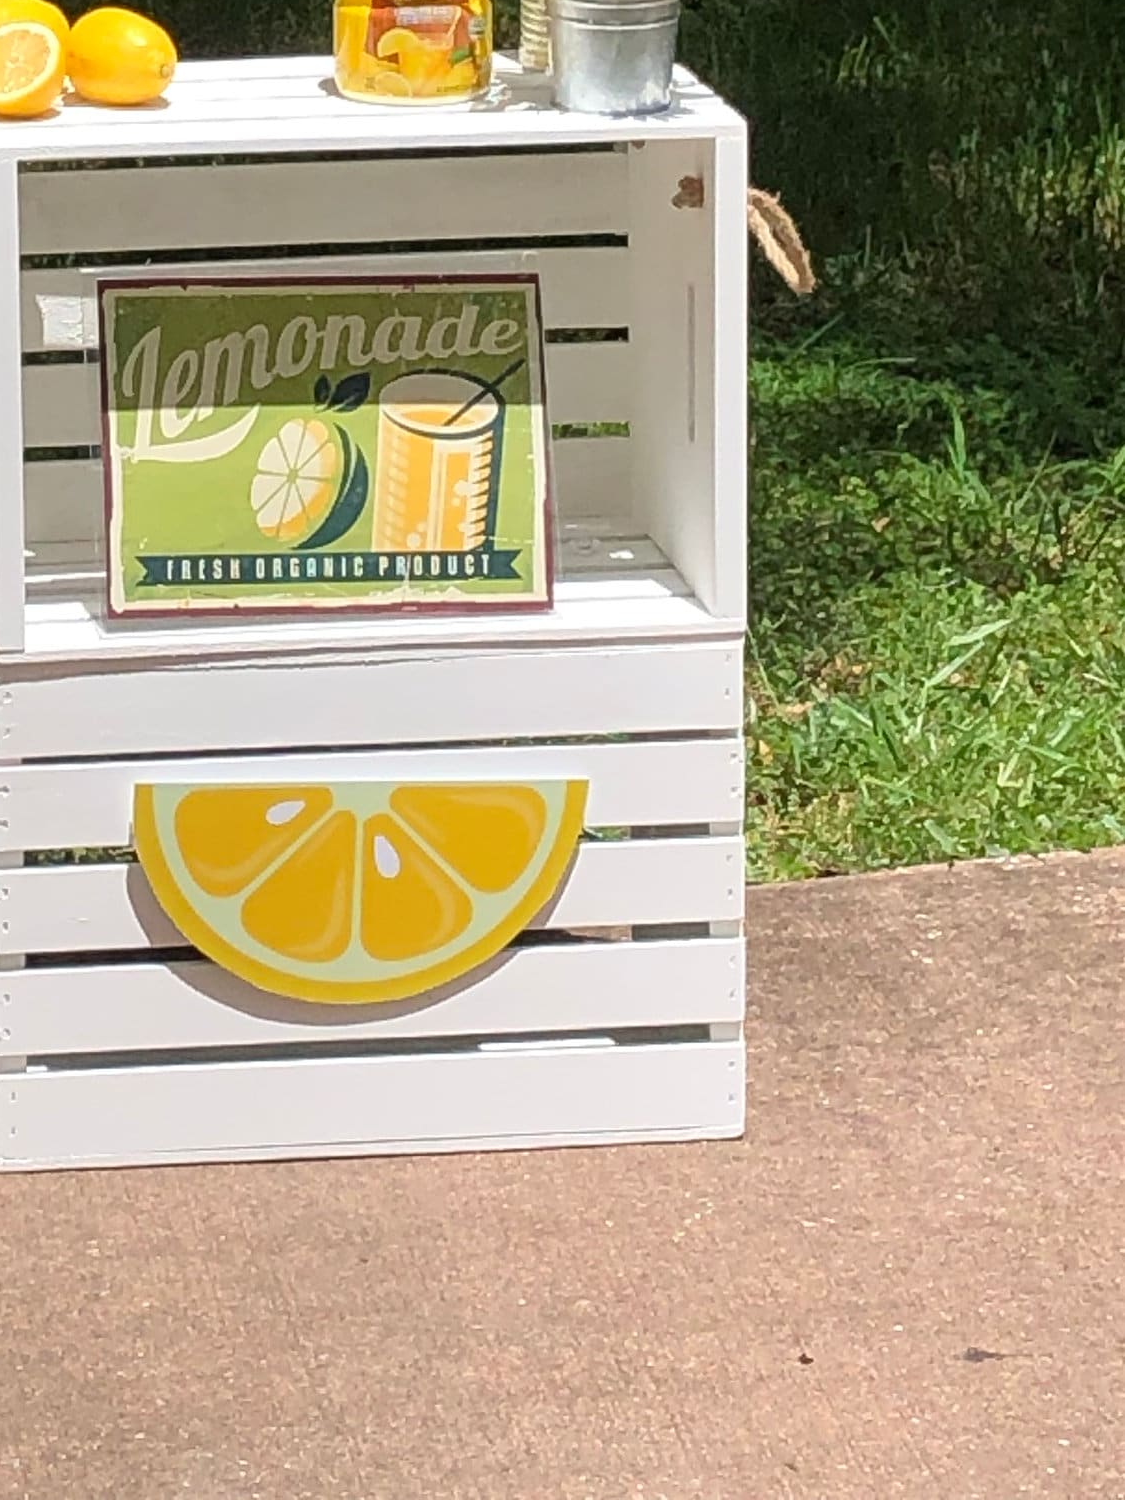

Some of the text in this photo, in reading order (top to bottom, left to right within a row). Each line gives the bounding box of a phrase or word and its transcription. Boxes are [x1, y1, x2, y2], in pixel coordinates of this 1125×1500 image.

[118, 304, 524, 463] Lemonade
[166, 553, 490, 581] FRESH ORGANIC PRODUCT
